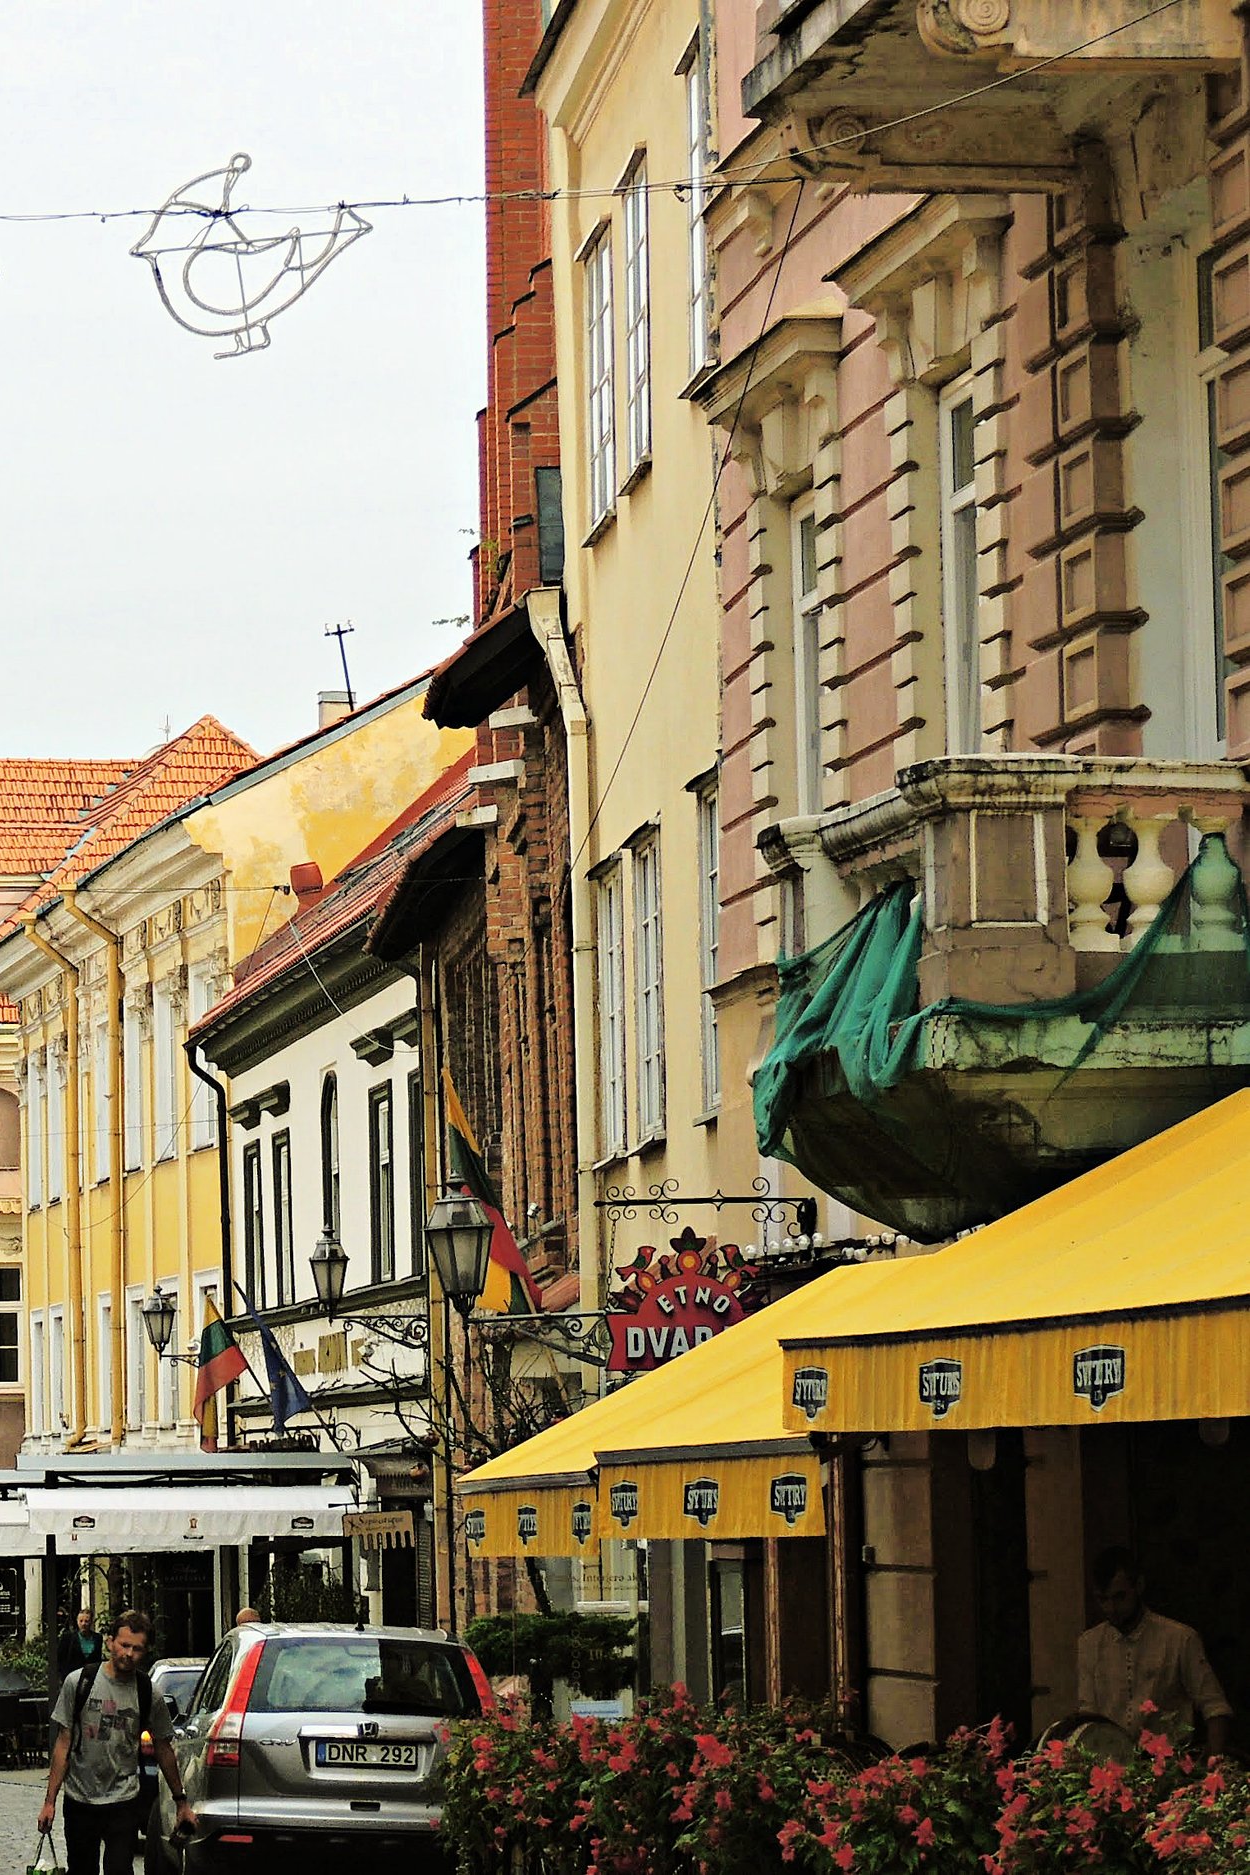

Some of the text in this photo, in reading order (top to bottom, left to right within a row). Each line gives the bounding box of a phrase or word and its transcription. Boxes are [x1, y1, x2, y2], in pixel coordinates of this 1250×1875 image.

[656, 1285, 731, 1314] ETNO
[626, 1325, 733, 1358] DVAR
[328, 1744, 368, 1762] DNR
[380, 1746, 415, 1764] 292
